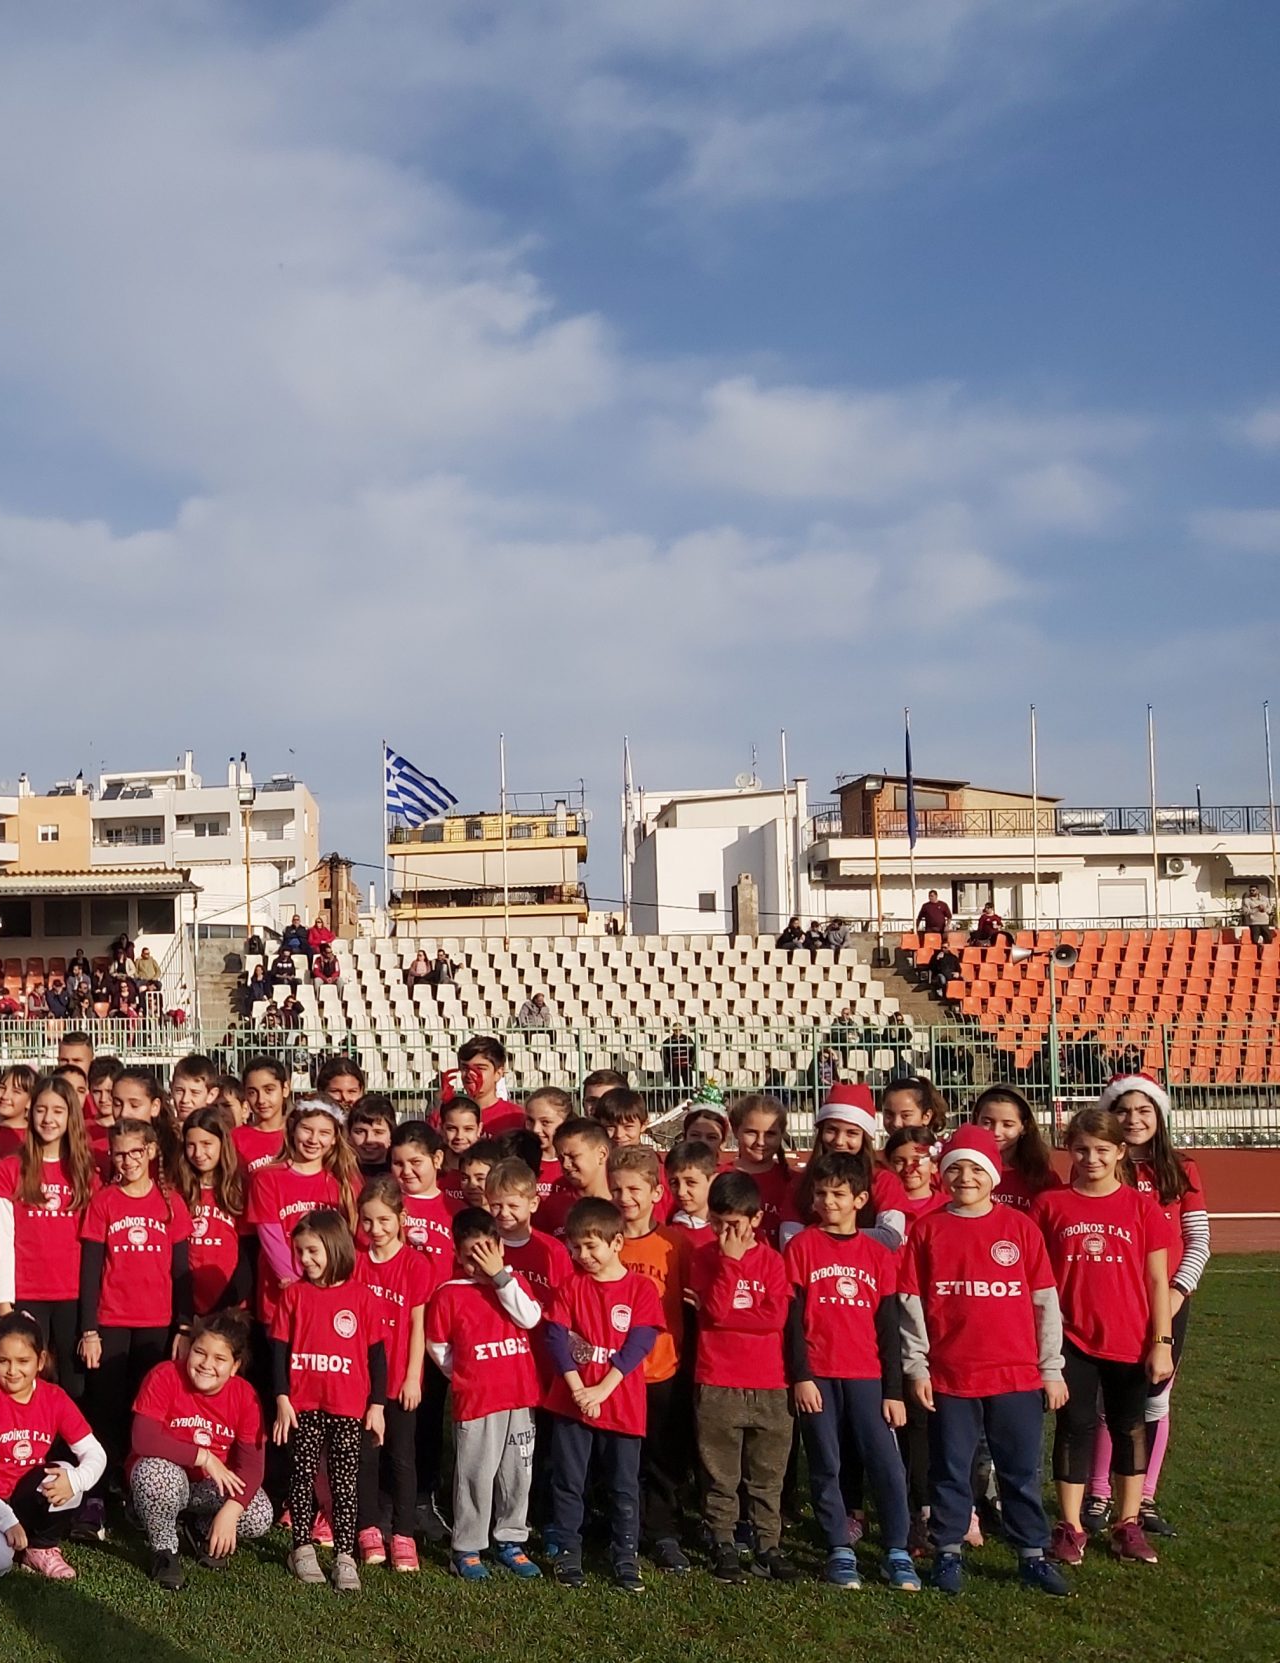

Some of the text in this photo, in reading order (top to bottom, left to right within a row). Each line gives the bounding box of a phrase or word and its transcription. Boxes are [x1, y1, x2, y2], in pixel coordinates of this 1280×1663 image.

[1066, 1253, 1124, 1264] ΣΤΙΒΟΣ
[809, 1263, 857, 1284] ΕΥΒΟΪΚΟΣ
[935, 1280, 1023, 1298] ΣΤΙΒΟΣ
[818, 1295, 872, 1309] ΣΤΙΒΟΣ
[291, 1352, 353, 1376] ΣΤΙΒΟΣ
